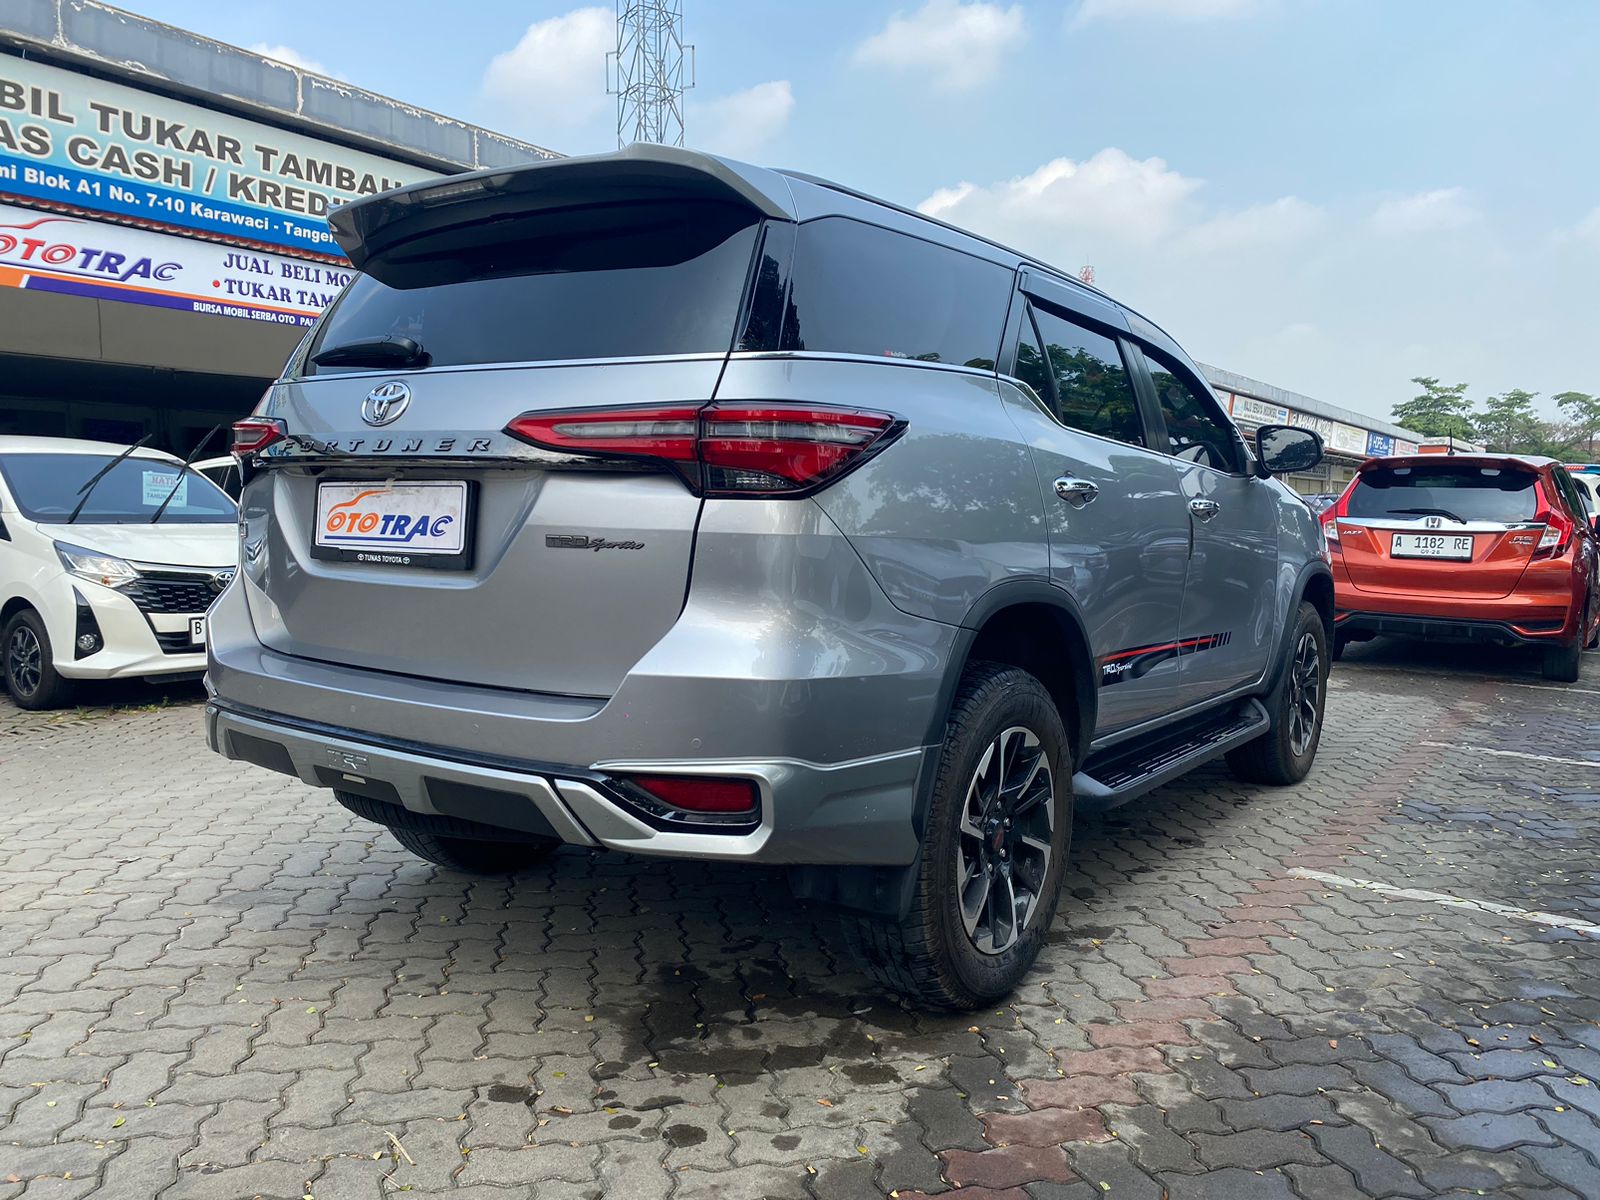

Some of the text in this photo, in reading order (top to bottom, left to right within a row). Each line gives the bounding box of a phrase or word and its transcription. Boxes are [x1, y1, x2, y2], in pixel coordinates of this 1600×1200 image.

[89, 101, 243, 165] TUKAR
[68, 136, 190, 188] CASH
[205, 167, 216, 193] /
[24, 166, 71, 191] Blok
[77, 178, 101, 197] A1
[109, 184, 141, 205] No.
[146, 192, 185, 214] 7-10
[191, 201, 269, 230] Karawaci
[223, 253, 353, 288] JUAL BELI MO
[224, 278, 292, 304] TUKAR
[193, 301, 223, 315] BURSA
[223, 305, 251, 319] MOBIL
[251, 309, 278, 323] SERBA
[278, 314, 296, 325] OTO
[283, 438, 492, 453] FORTUNER
[326, 510, 454, 543] OTOTRAC
[1394, 535, 1470, 551] A 1182 RE
[364, 553, 403, 564] TUNAS TOYOTA
[195, 621, 202, 635] B
